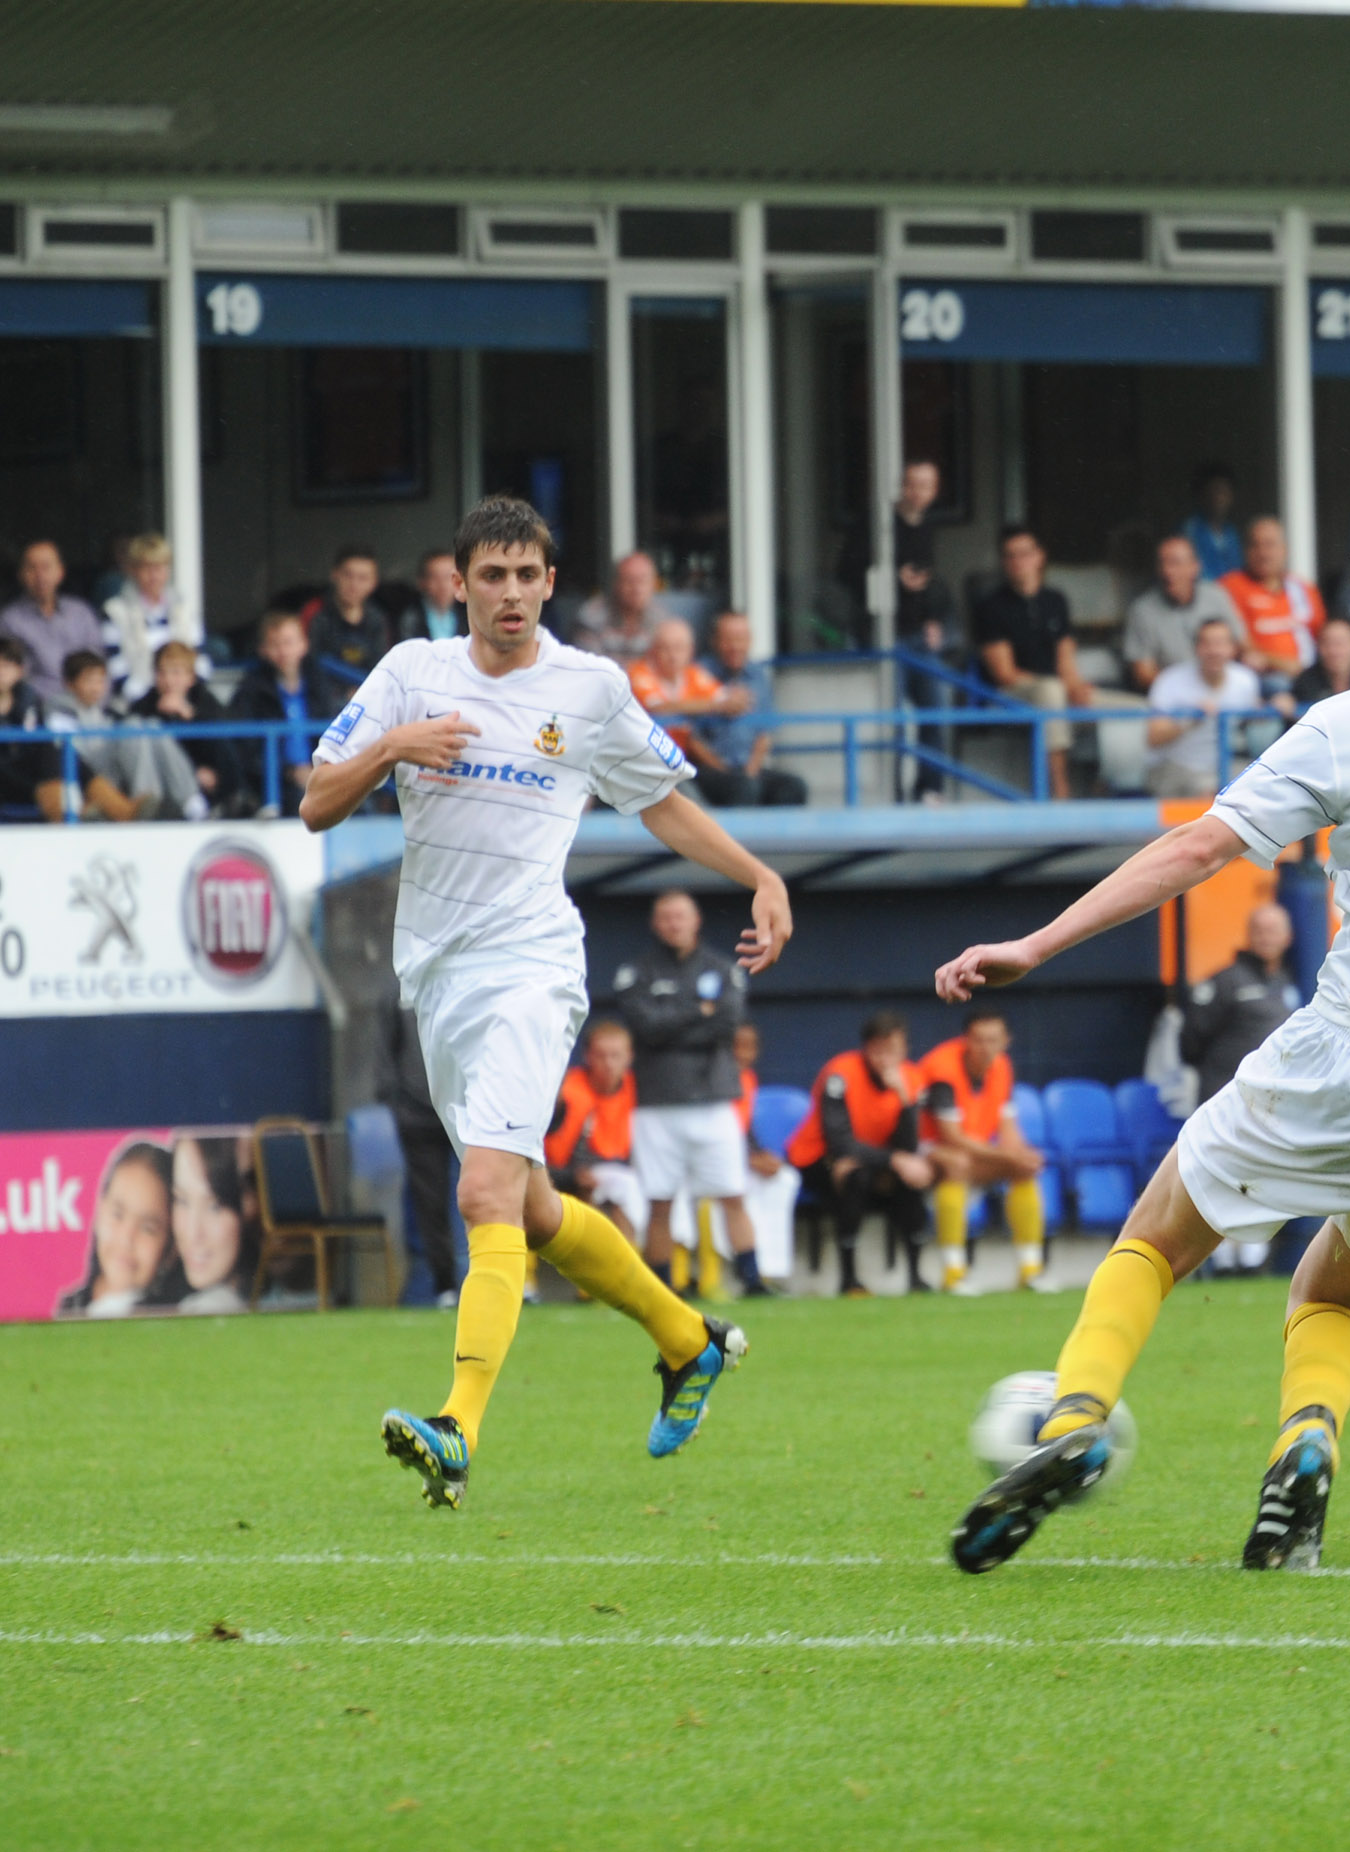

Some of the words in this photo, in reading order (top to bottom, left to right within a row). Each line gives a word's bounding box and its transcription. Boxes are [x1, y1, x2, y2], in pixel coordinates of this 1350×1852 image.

[206, 282, 262, 336] 19
[901, 288, 965, 342] 20
[418, 761, 556, 791] antec
[201, 879, 268, 953] FIAT
[29, 972, 194, 1000] PEUGEOT
